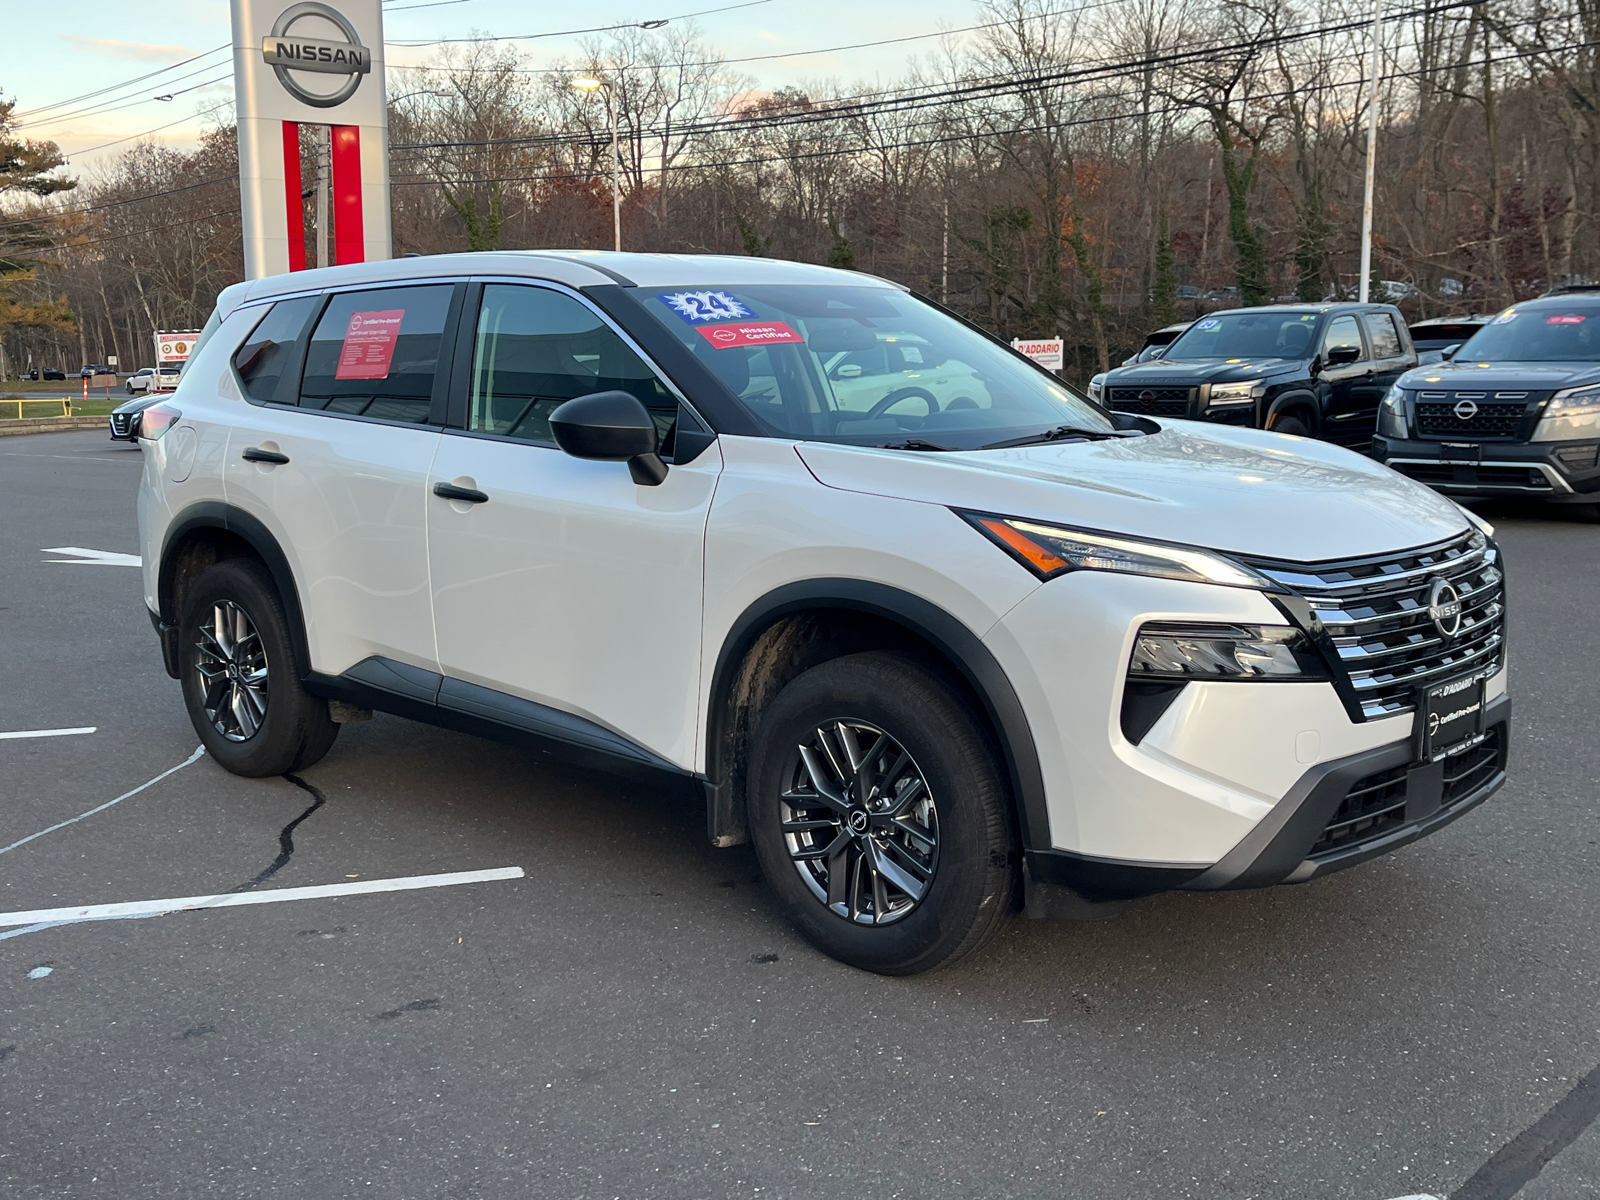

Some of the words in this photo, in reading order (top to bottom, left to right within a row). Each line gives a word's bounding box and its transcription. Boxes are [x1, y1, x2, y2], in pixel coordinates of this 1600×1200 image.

[276, 42, 363, 66] NISSAN
[685, 295, 731, 315] 24
[746, 331, 791, 339] Certified
[1018, 343, 1060, 354] D'ADDARIO
